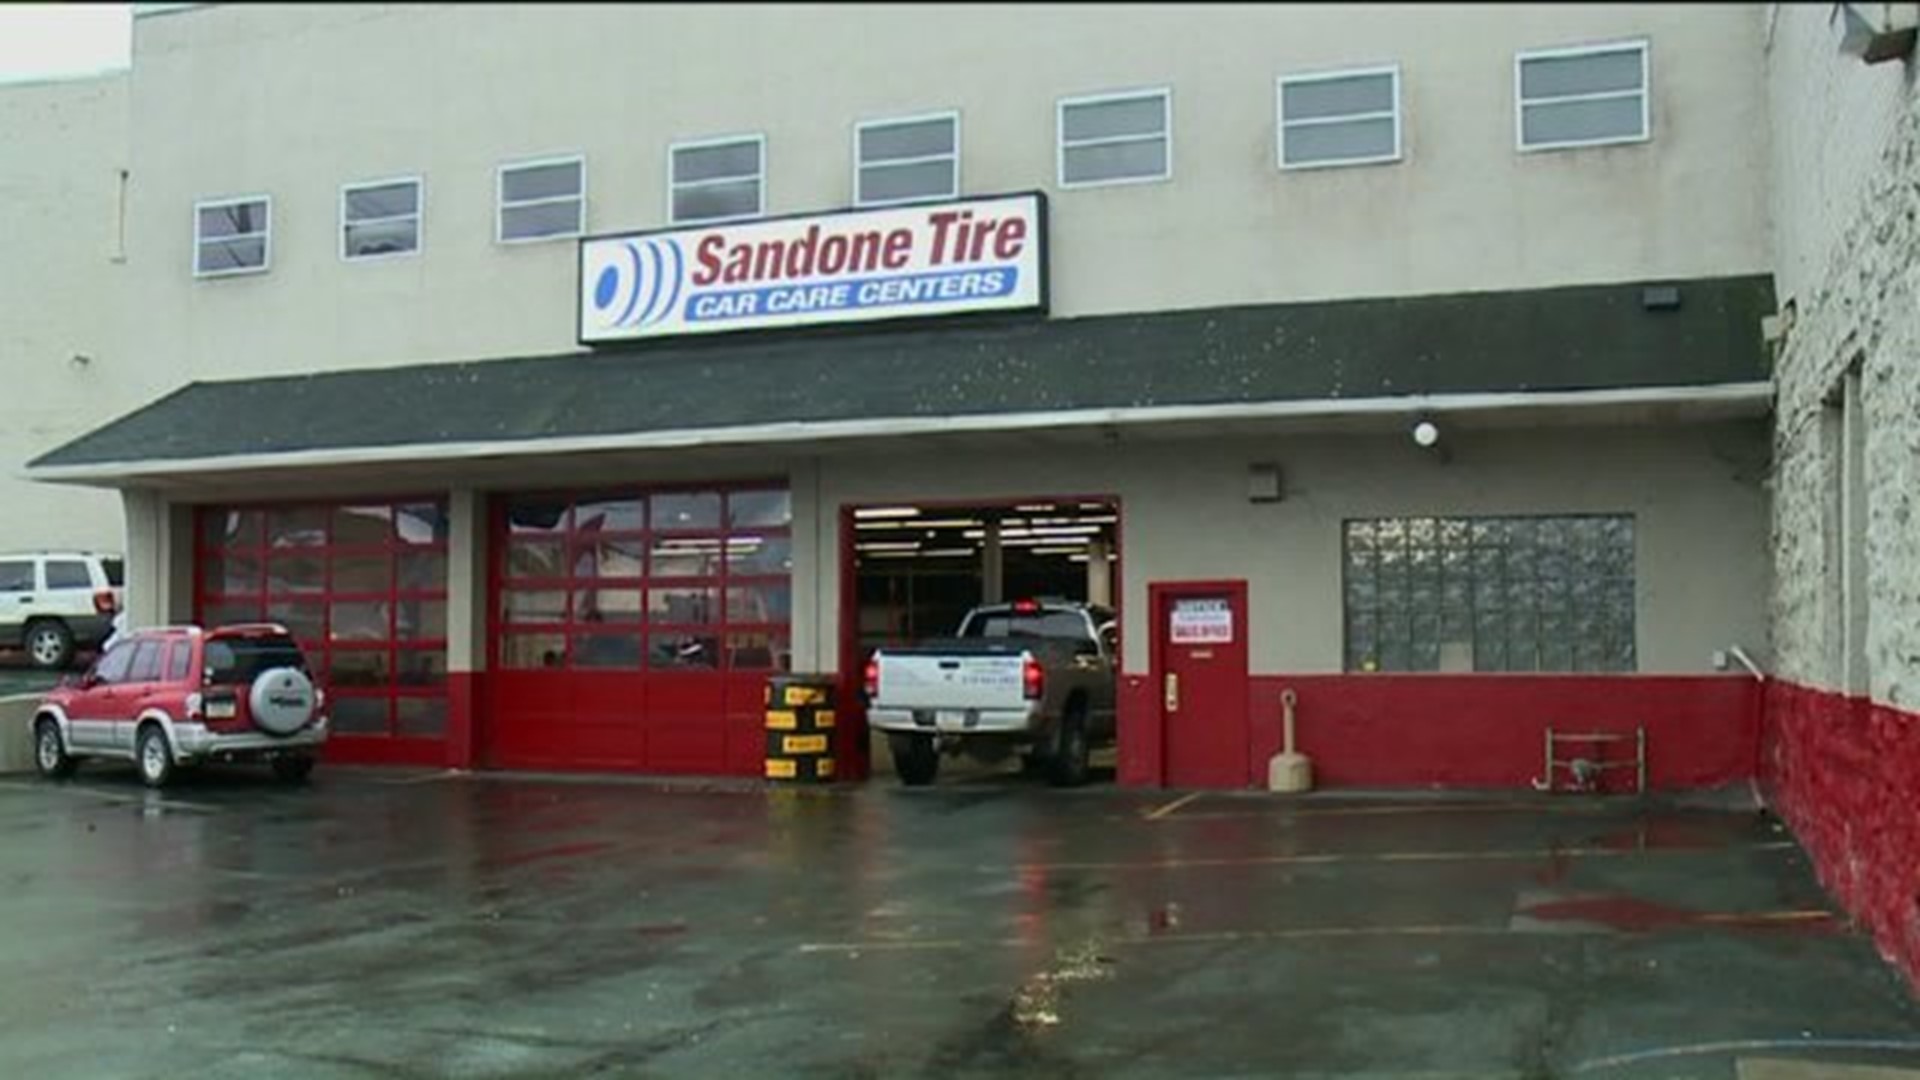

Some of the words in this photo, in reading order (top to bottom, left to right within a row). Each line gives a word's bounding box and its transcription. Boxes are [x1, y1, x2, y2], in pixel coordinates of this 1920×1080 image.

[693, 226, 912, 285] Sandone
[929, 211, 1025, 265] Tire
[696, 291, 757, 317] CAR
[767, 285, 848, 311] CARE
[858, 273, 1003, 302] CENTERS
